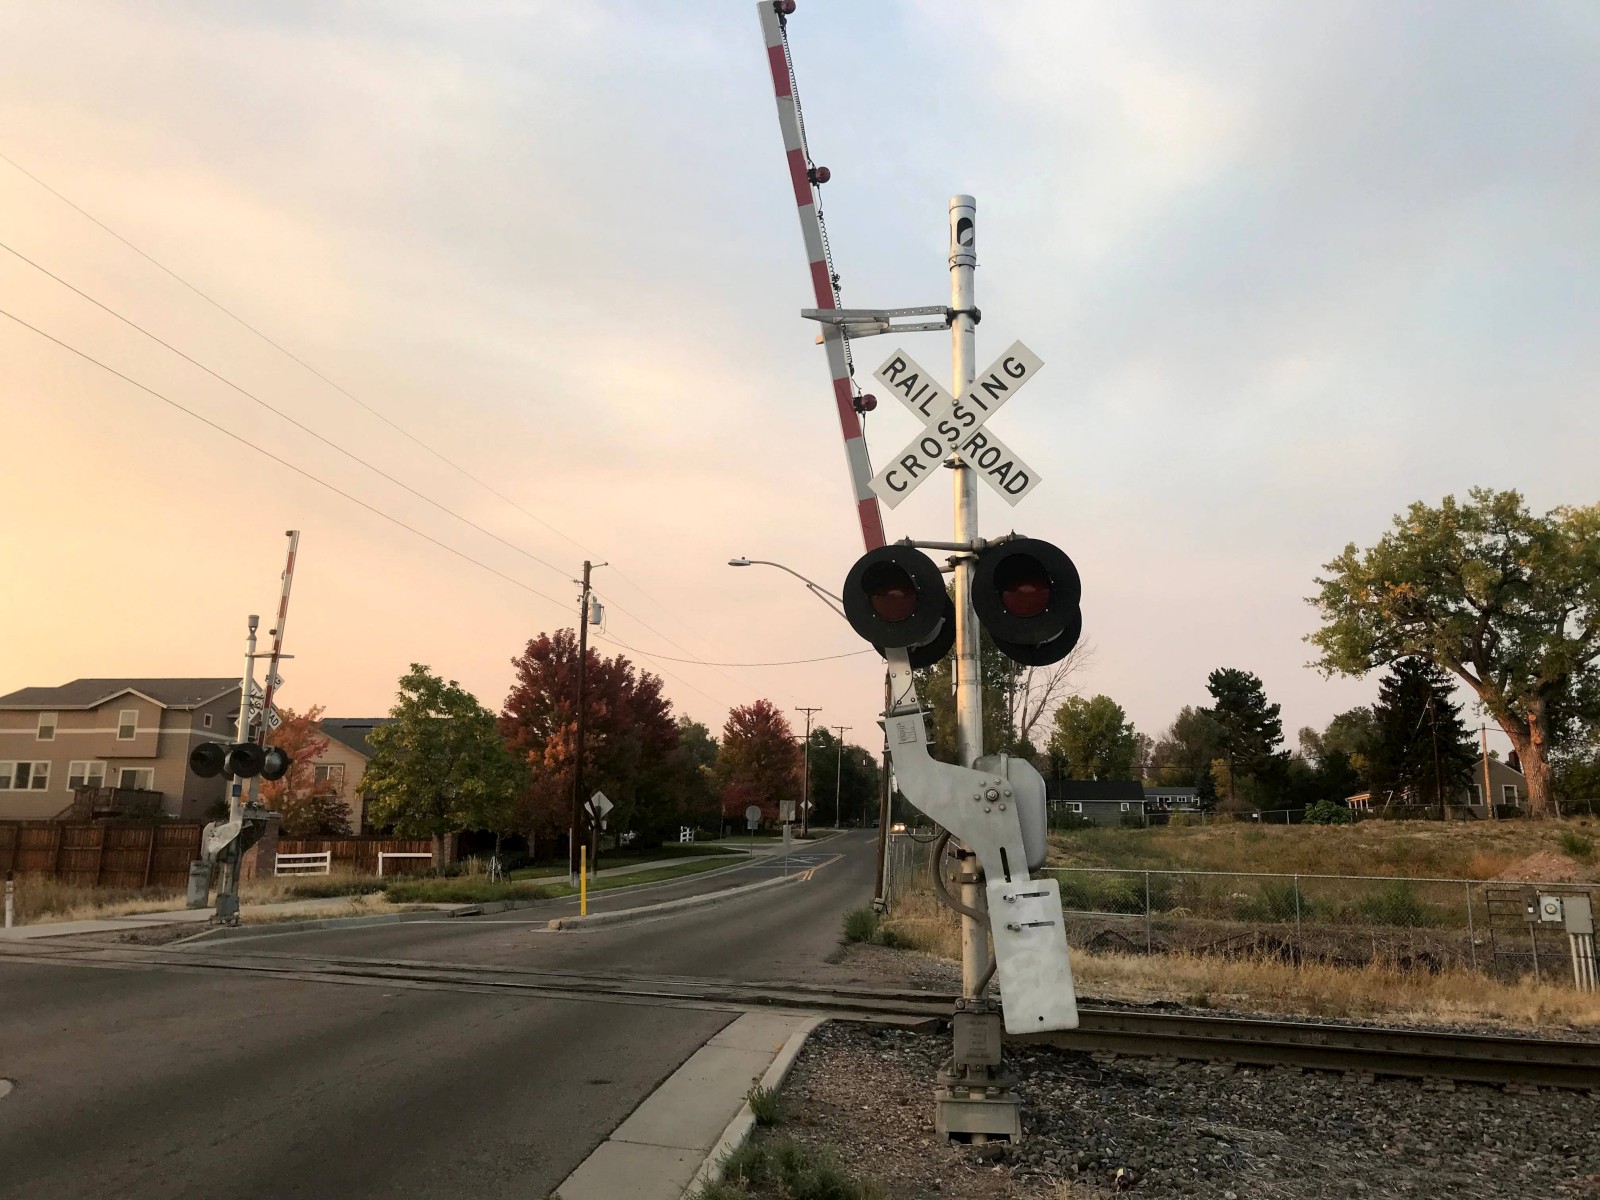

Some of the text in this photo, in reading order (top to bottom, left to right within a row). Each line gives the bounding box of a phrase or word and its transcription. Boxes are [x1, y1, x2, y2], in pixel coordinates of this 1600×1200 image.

[882, 356, 1029, 495] RAIL ROAD
[885, 356, 1026, 492] CROSSING
